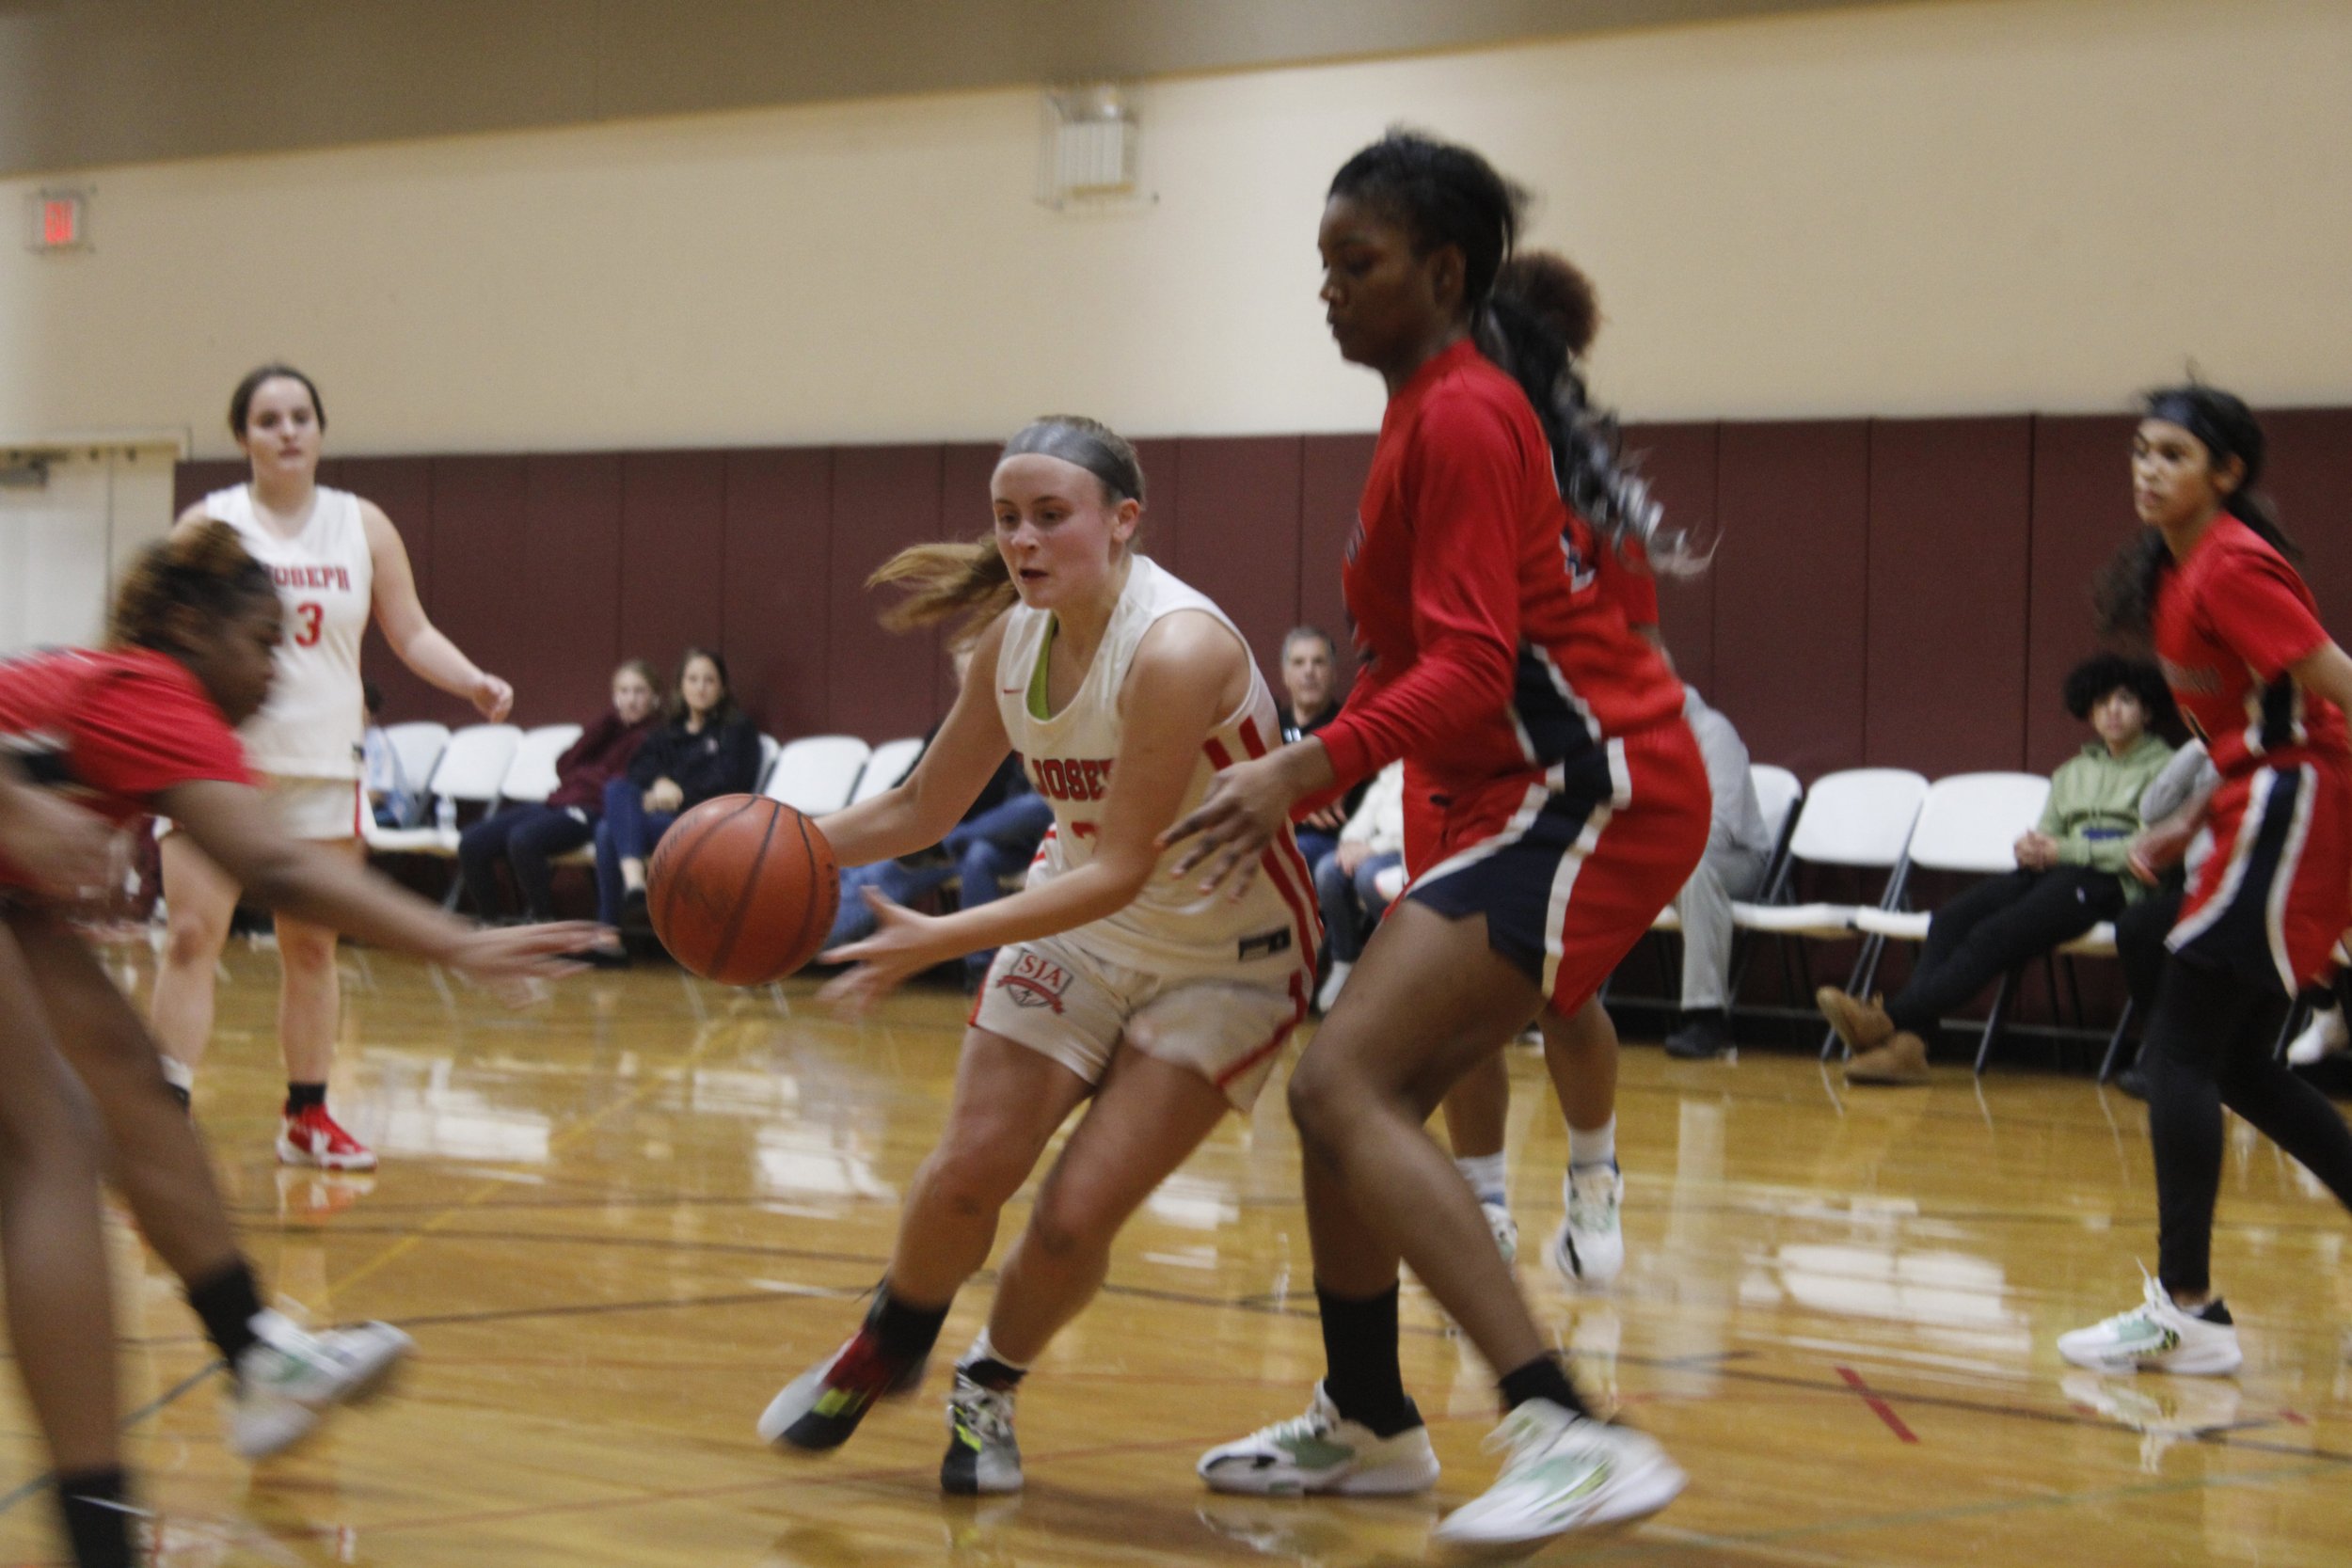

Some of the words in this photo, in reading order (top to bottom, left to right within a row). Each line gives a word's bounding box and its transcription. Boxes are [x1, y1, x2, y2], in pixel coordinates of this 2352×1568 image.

[268, 566, 350, 591] OSEPH
[294, 602, 324, 647] 3
[1019, 954, 1064, 988] SJA
